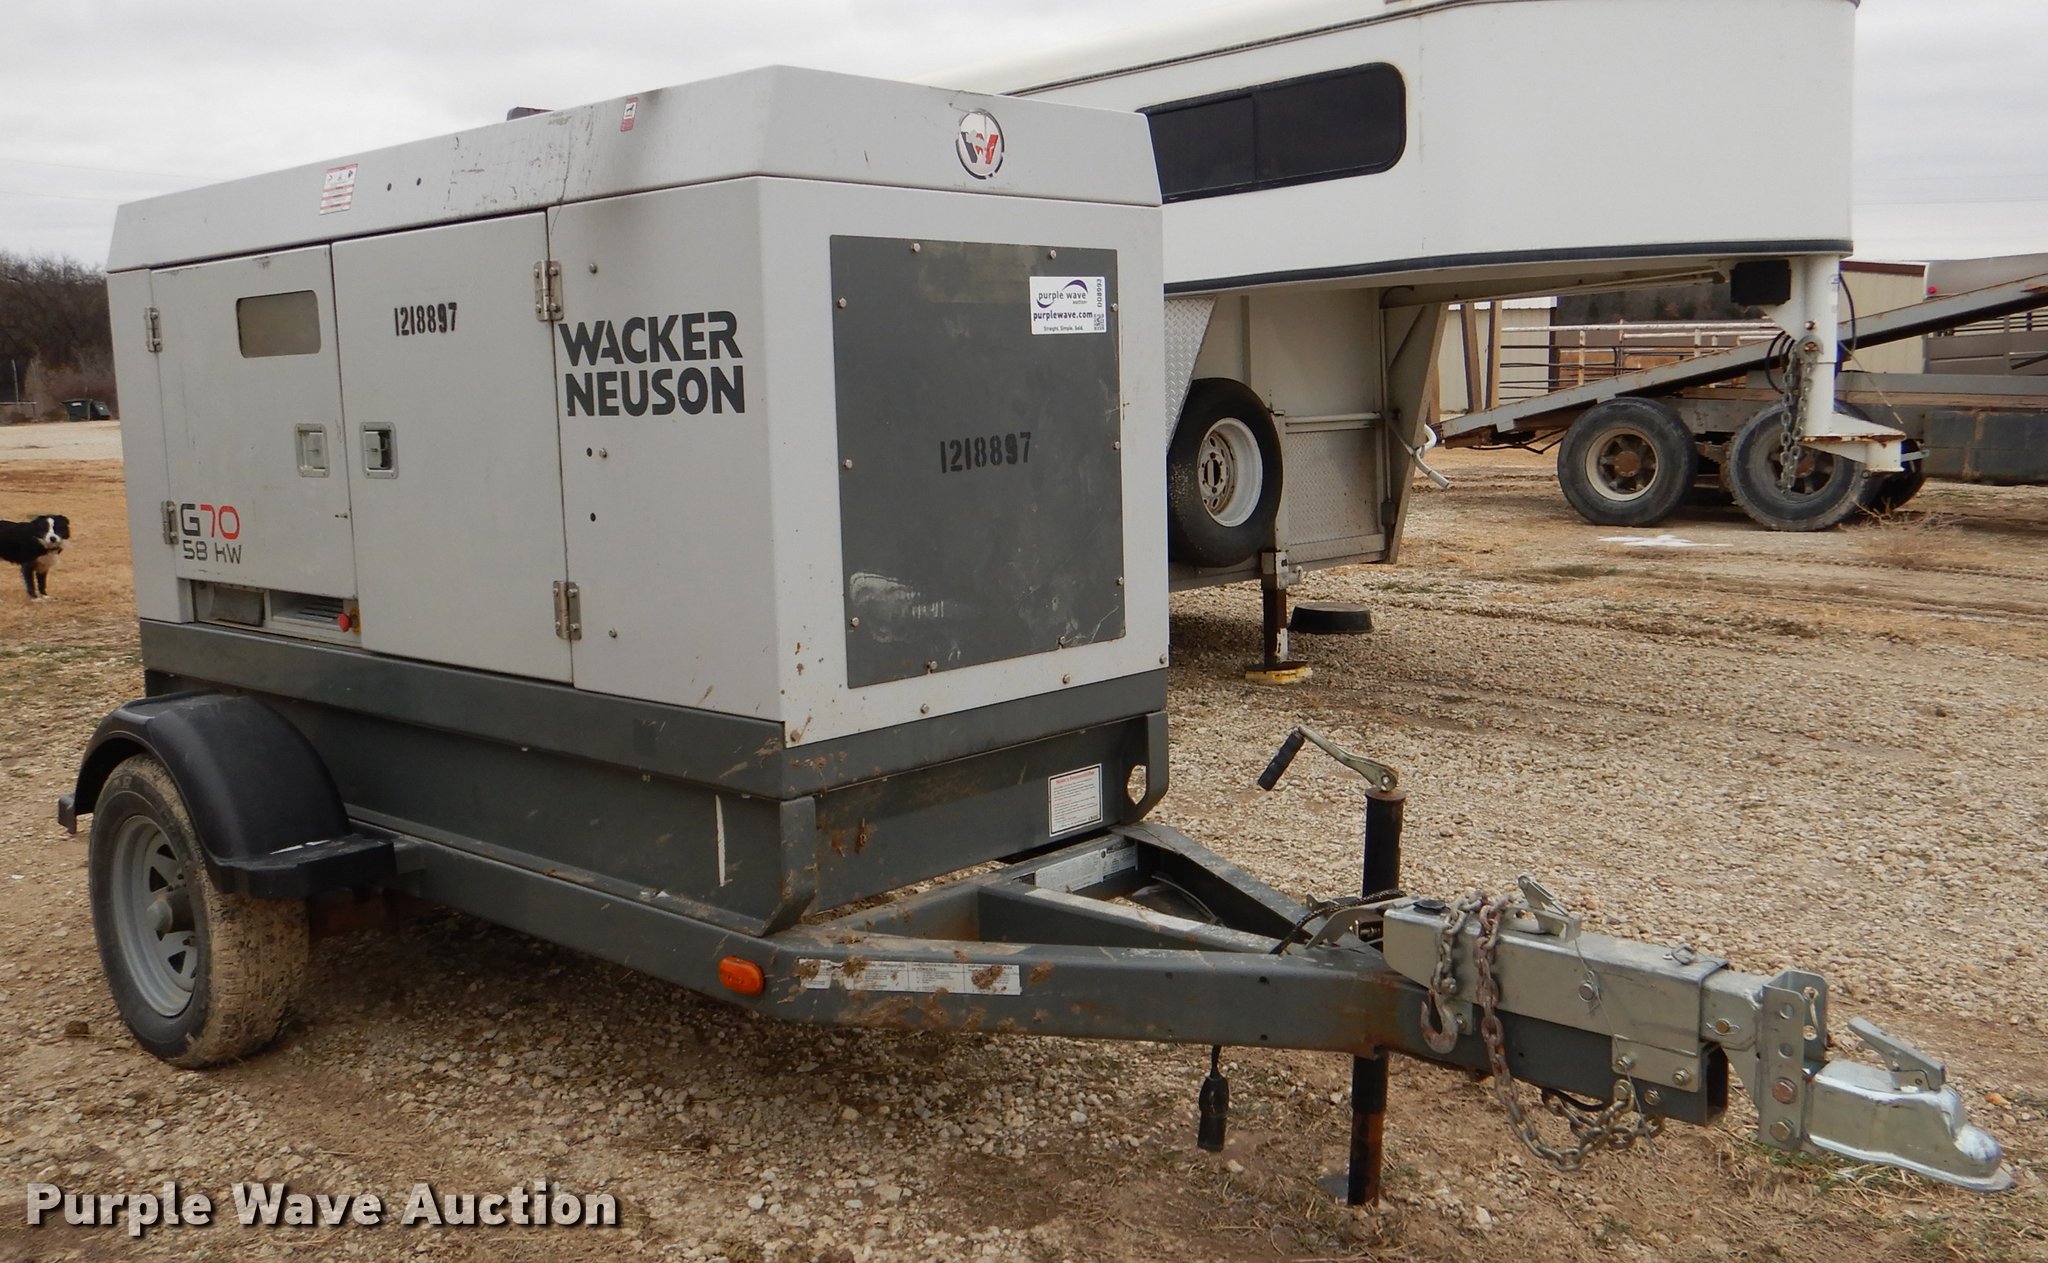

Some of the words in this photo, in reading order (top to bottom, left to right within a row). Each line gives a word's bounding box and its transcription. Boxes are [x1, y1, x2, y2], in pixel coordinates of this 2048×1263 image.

[1039, 291, 1063, 300] purple
[394, 302, 457, 336] 1218897
[1034, 310, 1092, 321] purplewave.com
[558, 310, 743, 367] WACKER
[565, 365, 745, 417] NEUSON
[940, 431, 1031, 474] 1218897
[180, 503, 240, 540] G70
[183, 540, 208, 561] 58
[214, 542, 242, 564] kW
